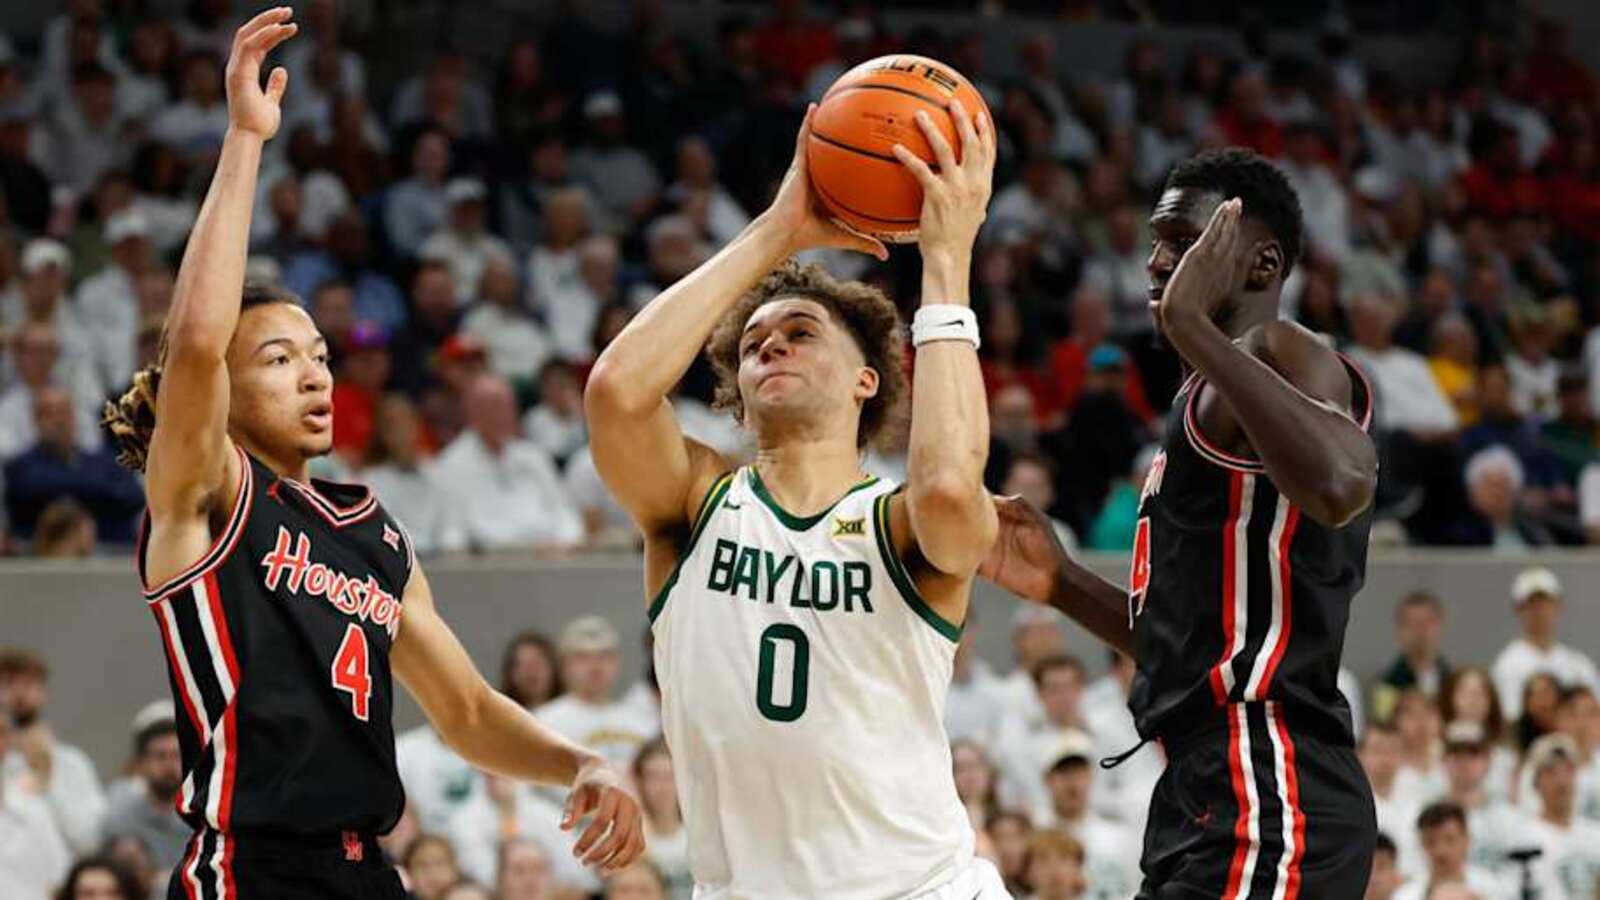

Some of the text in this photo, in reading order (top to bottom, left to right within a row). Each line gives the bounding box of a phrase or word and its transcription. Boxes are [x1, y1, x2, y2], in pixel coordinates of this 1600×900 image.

[707, 538, 873, 613] BAYLOR
[331, 622, 372, 722] 4
[757, 623, 810, 722] 0
